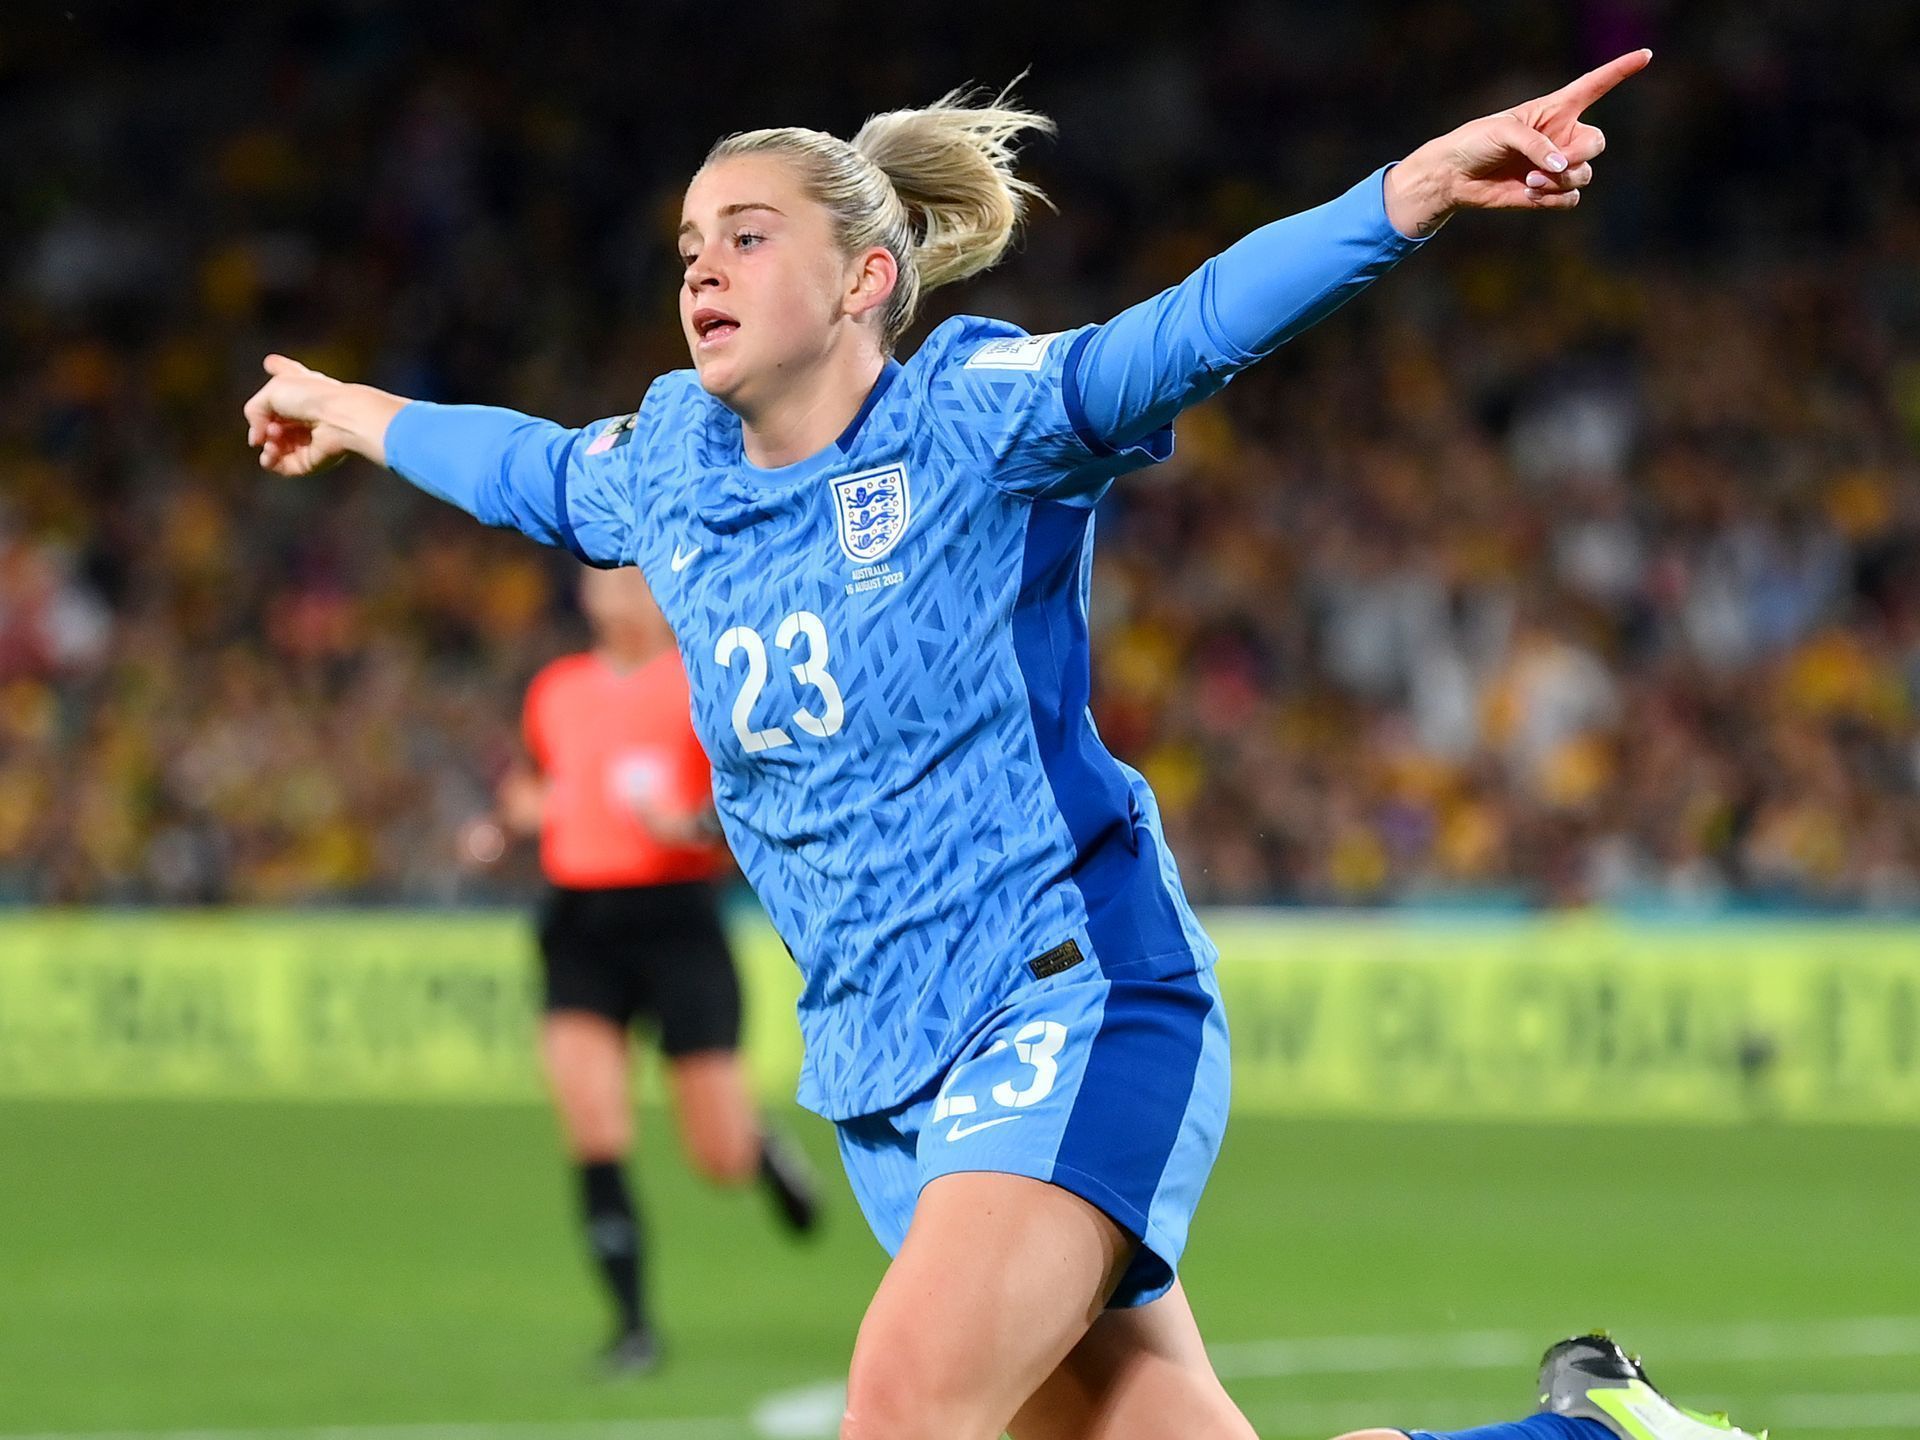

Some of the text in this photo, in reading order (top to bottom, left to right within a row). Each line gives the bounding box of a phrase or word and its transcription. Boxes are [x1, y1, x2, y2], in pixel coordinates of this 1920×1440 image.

[845, 571, 904, 595] 16 AUGUST 2023
[852, 563, 889, 580] AUSTRALIA
[714, 611, 845, 753] 23
